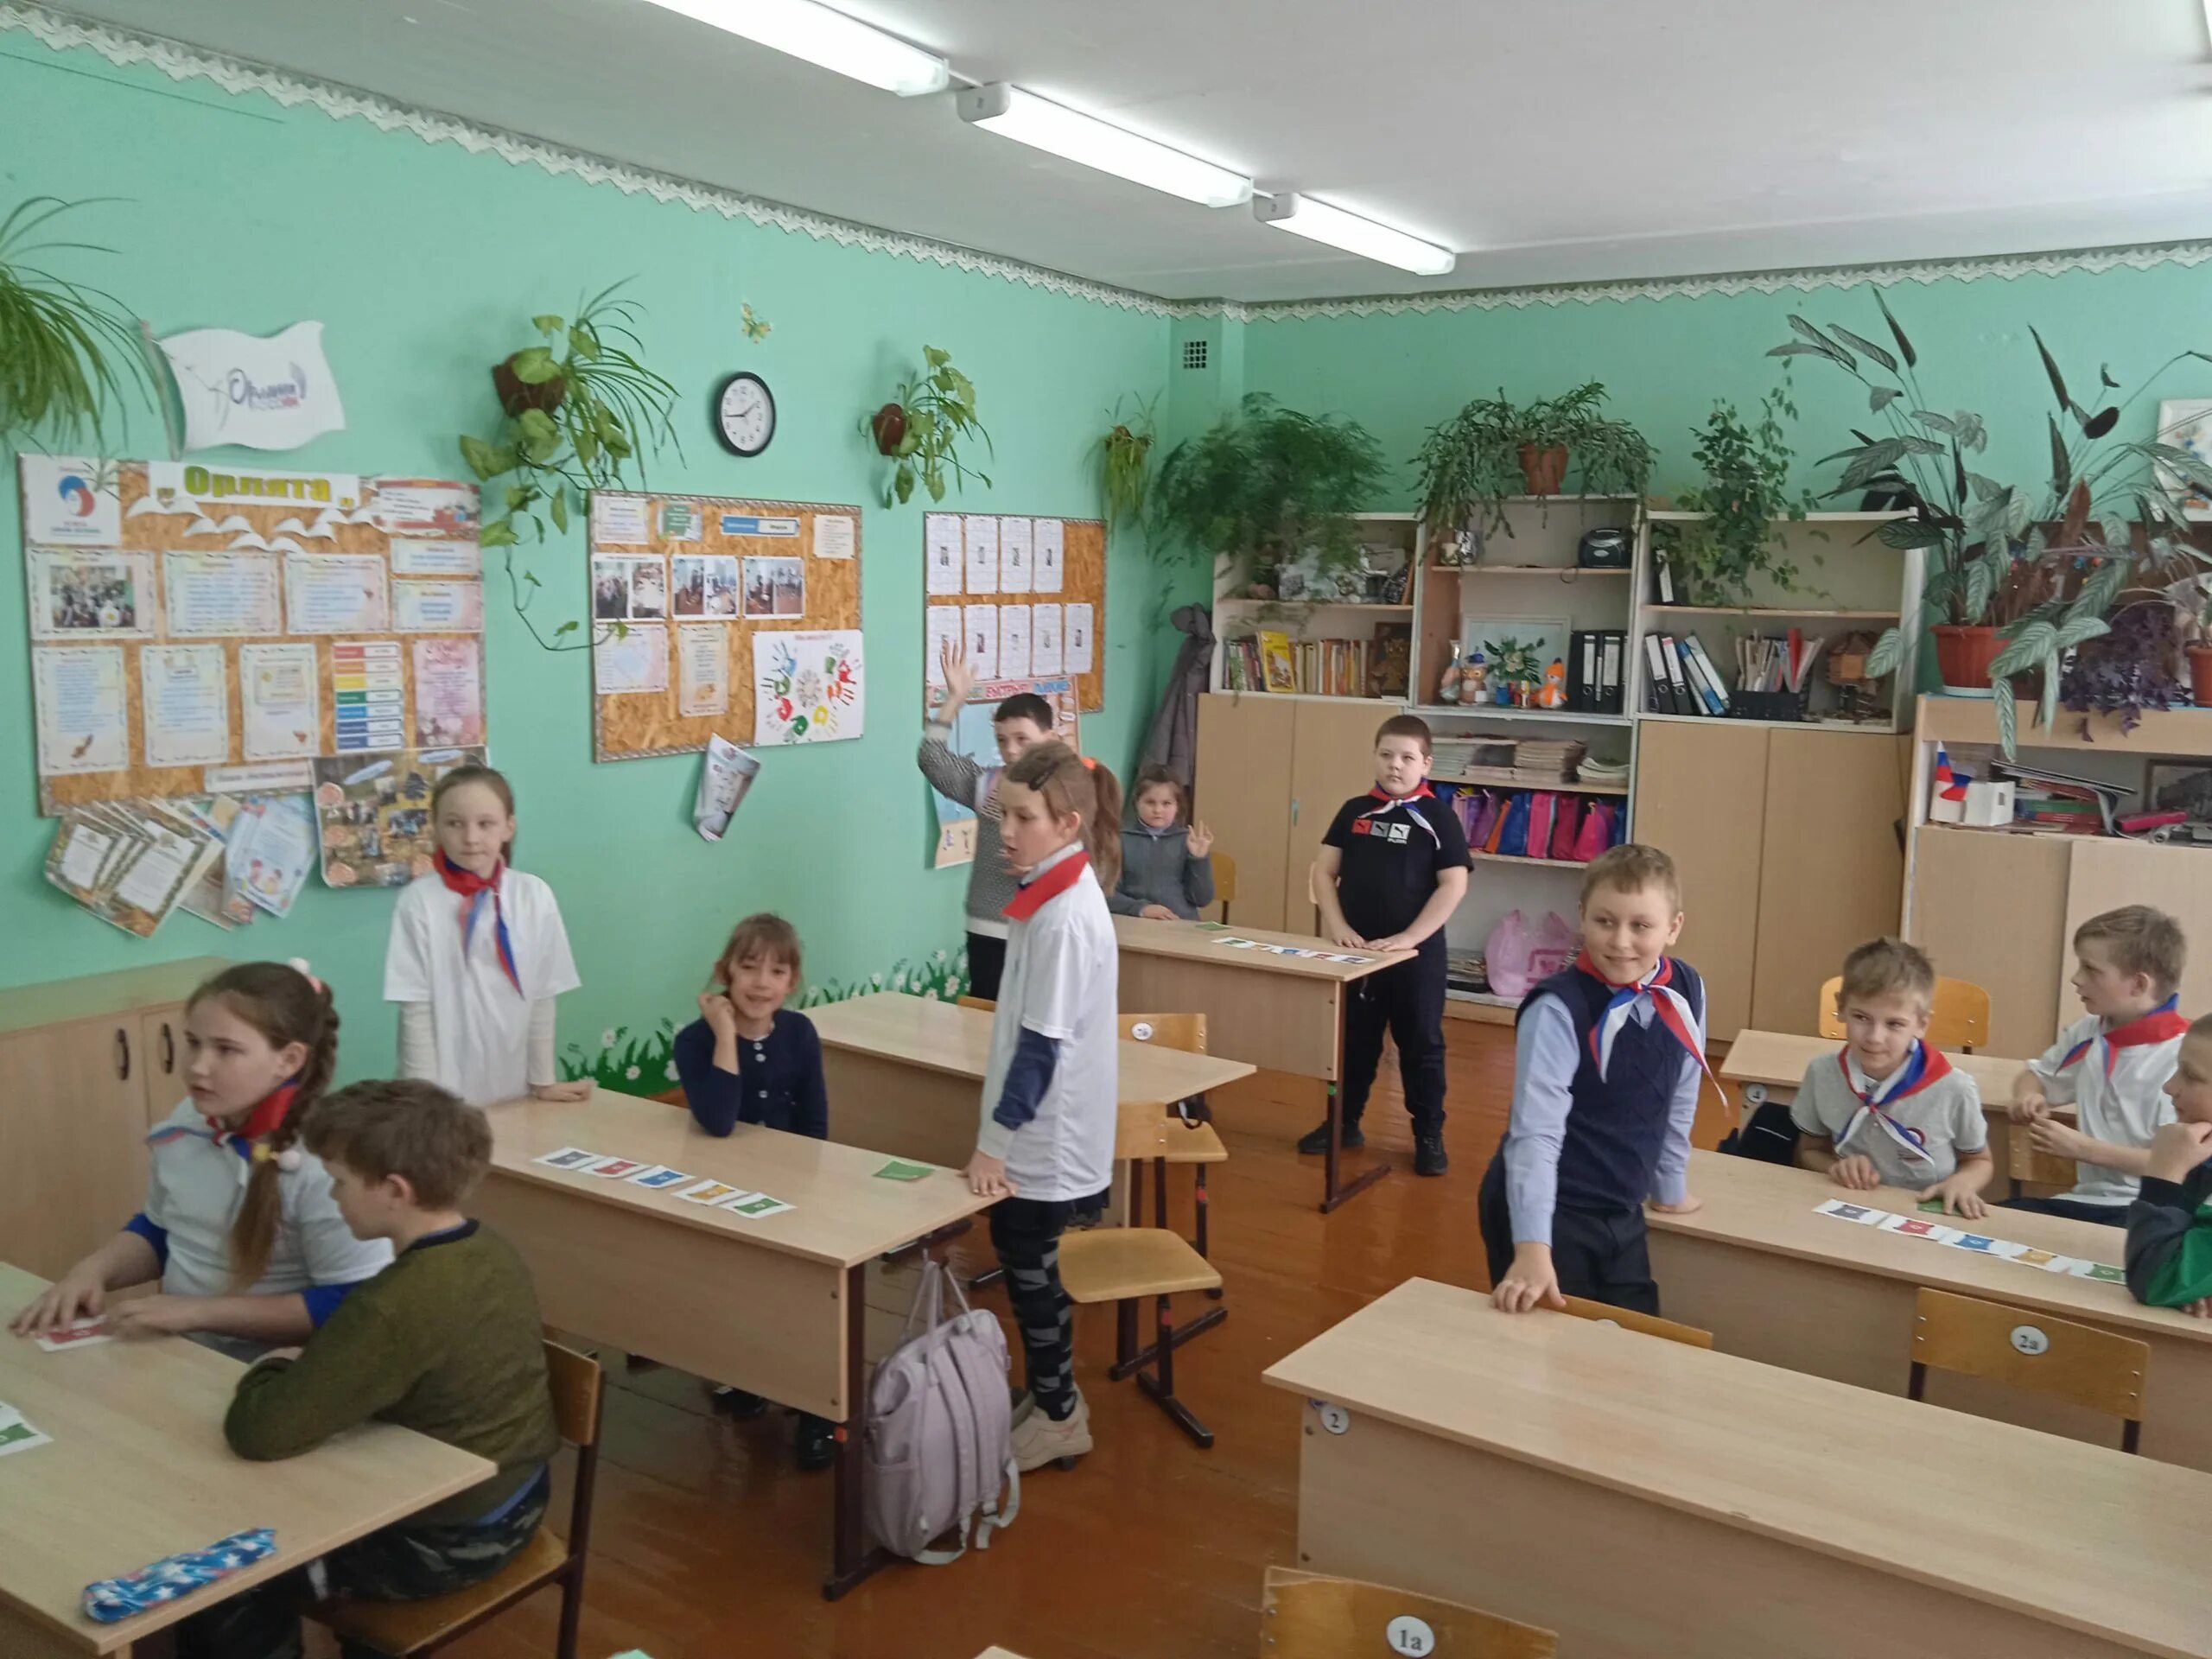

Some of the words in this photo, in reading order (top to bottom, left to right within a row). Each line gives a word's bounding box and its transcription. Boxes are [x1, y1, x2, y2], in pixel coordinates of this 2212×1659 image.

[184, 465, 332, 502] Орлята
[1330, 1413, 1340, 1428] 2
[1400, 1630, 1422, 1651] 1а
